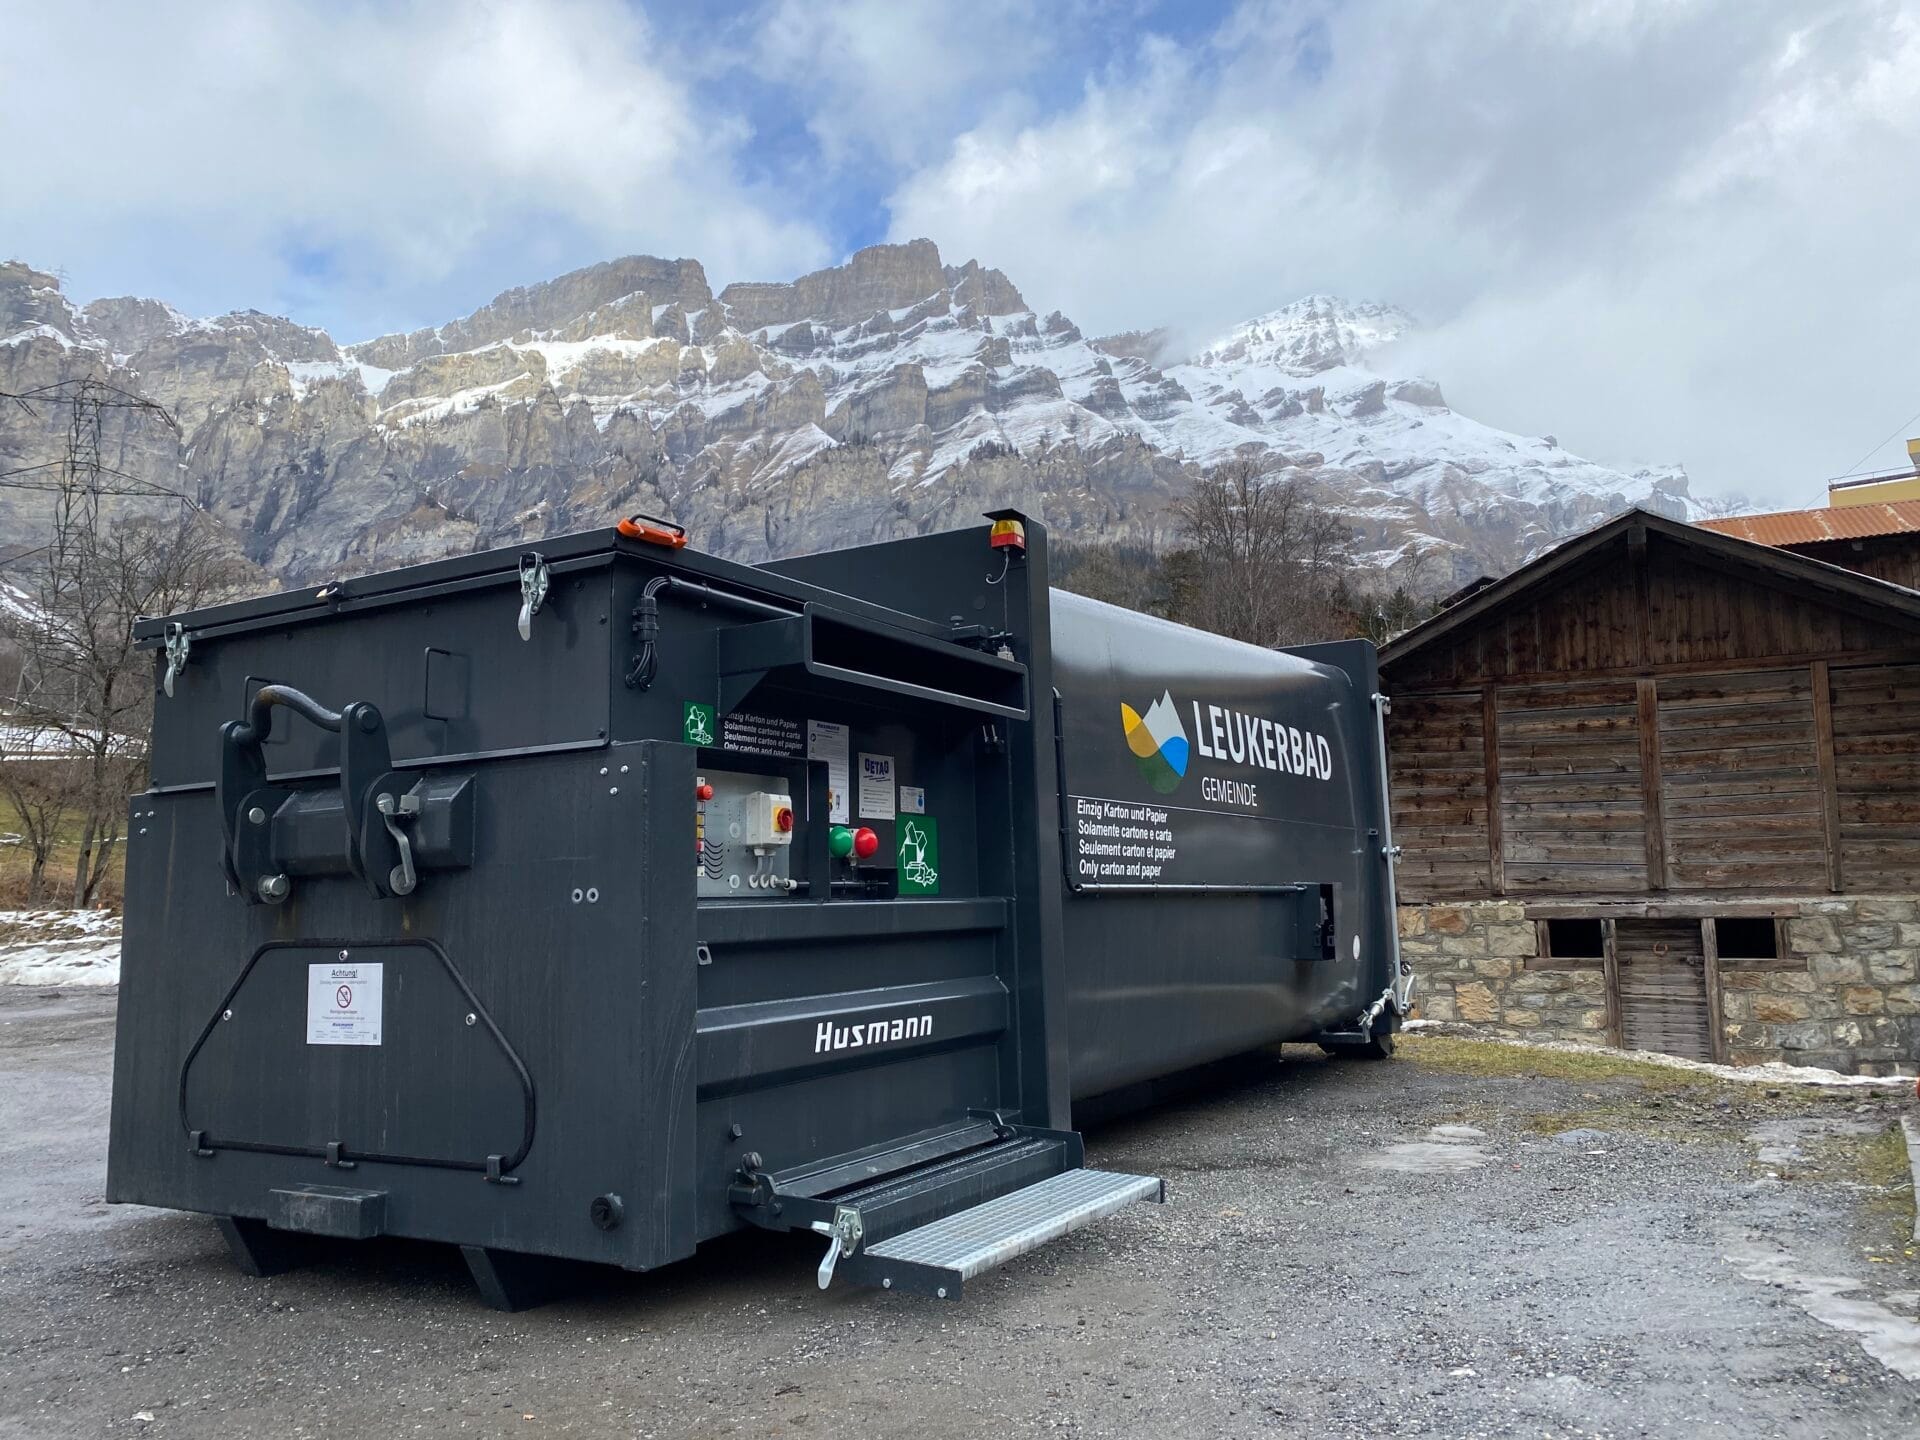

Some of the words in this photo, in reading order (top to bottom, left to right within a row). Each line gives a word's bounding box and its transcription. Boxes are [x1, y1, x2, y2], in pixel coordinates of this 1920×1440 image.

[724, 721, 757, 734] Solamente
[758, 728, 780, 737] cartone
[786, 731, 801, 740] carta
[727, 712, 744, 723] inzig
[745, 713, 766, 725] Karton
[766, 718, 779, 726] und
[779, 719, 798, 729] Papier
[723, 741, 740, 751] Only
[740, 744, 760, 753] carton
[760, 747, 773, 755] and
[724, 731, 757, 744] Seulement
[758, 737, 777, 746] carton
[1193, 700, 1332, 781] LEUKERBAD
[1201, 776, 1258, 807] GEMEINDE
[1077, 799, 1102, 820] Einzig
[1104, 802, 1129, 820] Karton
[1130, 807, 1145, 821] und
[1146, 807, 1168, 825] Papier
[1078, 819, 1120, 838] Solamente
[1121, 825, 1149, 840] cartone
[1149, 829, 1154, 840] e
[1155, 828, 1172, 842] carta
[1079, 838, 1121, 857] Seulement
[1122, 843, 1145, 858] carton
[1146, 844, 1154, 858] et
[1154, 845, 1176, 862] papier
[1079, 858, 1099, 878] Only
[1100, 861, 1125, 876] carton
[1126, 861, 1141, 876] and
[1141, 865, 1162, 880] paper
[331, 969, 358, 978] Achtung!
[814, 1015, 933, 1053] Husmann
